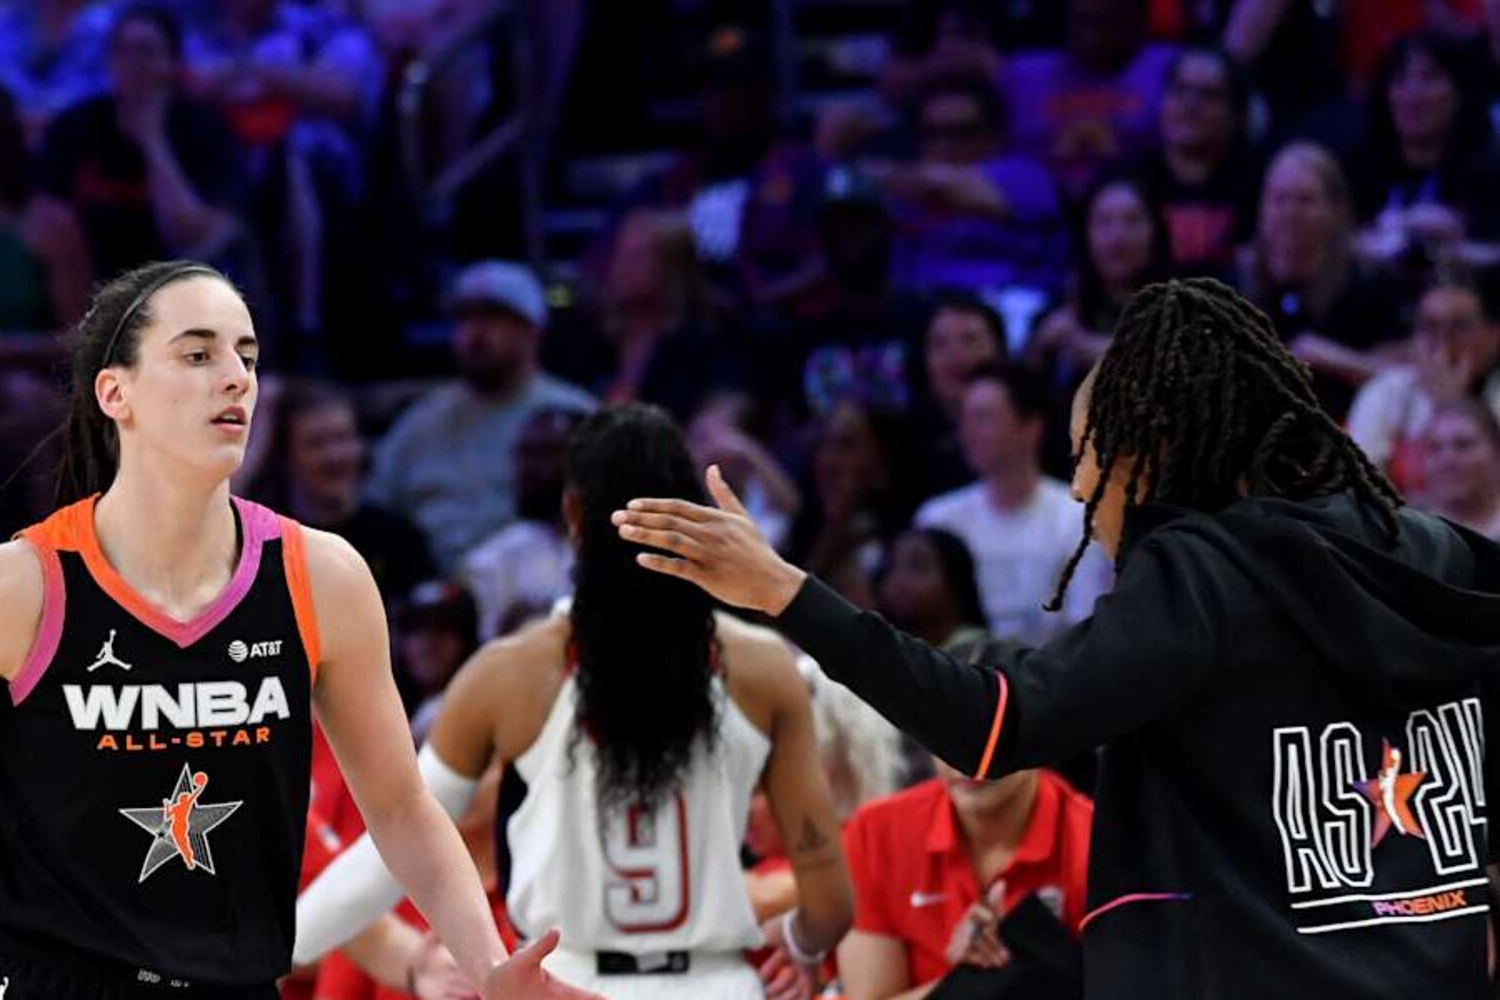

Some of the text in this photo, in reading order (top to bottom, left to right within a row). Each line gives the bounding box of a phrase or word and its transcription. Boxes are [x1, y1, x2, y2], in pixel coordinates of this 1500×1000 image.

[250, 640, 283, 658] AT&T
[62, 676, 291, 731] WNBA
[97, 727, 271, 750] ALL-STAR
[603, 776, 691, 934] 9
[1372, 890, 1468, 916] PHOENIX
